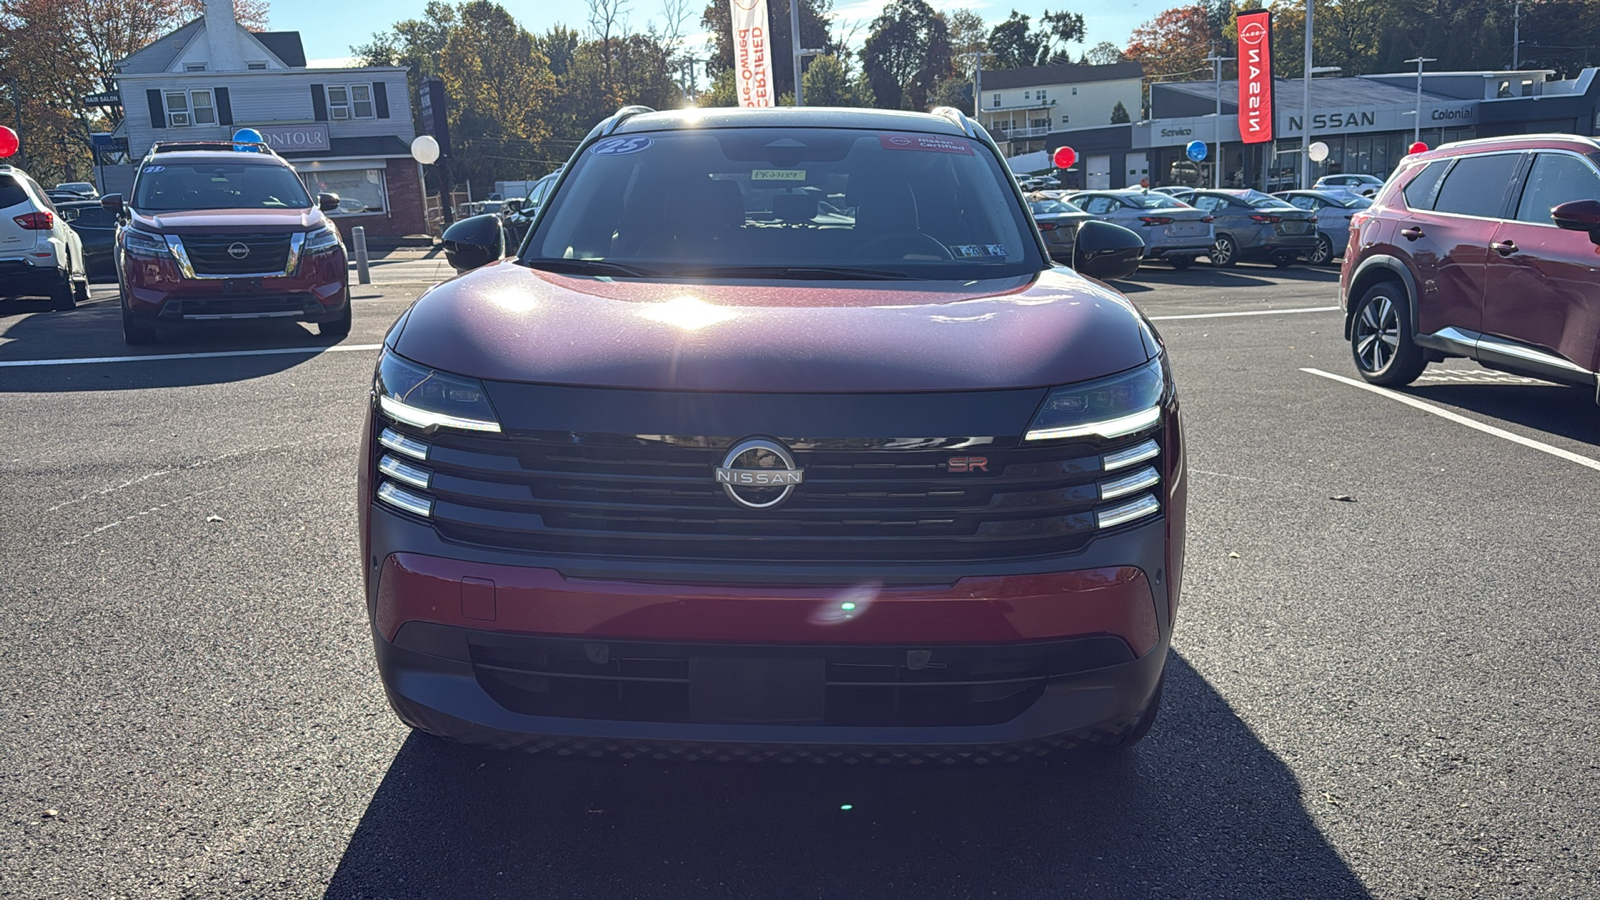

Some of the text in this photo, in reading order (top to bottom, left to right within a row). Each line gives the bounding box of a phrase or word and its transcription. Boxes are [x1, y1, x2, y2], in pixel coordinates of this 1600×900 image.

[1288, 108, 1474, 131] NSSAN Colonial
[1160, 127, 1192, 138] Service
[597, 137, 646, 154] 25
[919, 142, 966, 151] Certified
[948, 456, 989, 473] SR
[717, 470, 801, 485] NISSAN
